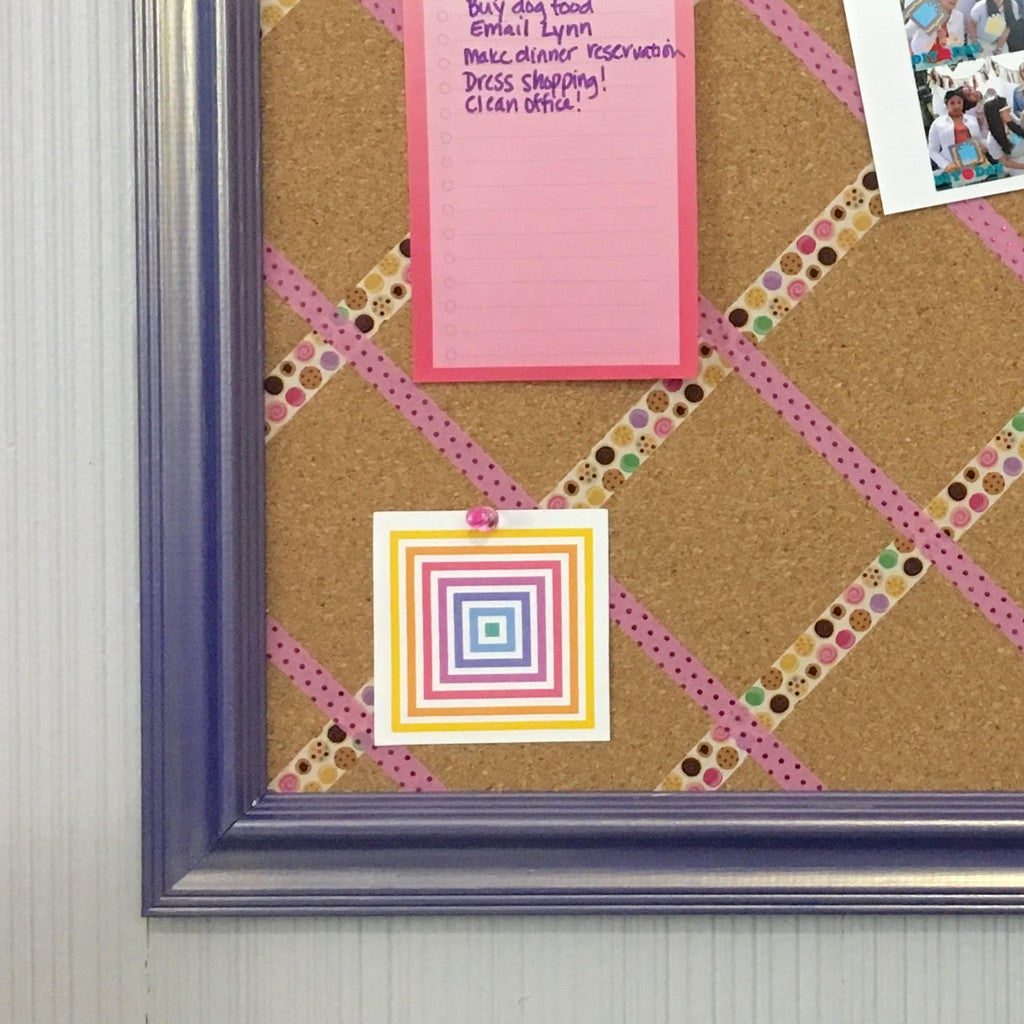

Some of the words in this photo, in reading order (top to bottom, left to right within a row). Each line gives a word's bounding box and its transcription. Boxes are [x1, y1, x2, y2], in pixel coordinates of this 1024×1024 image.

[470, 15, 529, 37] Email
[540, 20, 592, 45] Lynn
[463, 47, 513, 66] Make
[516, 45, 578, 64] dinner
[587, 38, 685, 61] reservation
[462, 71, 514, 93] Dress
[522, 65, 606, 99] shopping!
[465, 95, 518, 113] Clean
[524, 91, 581, 113] office!
